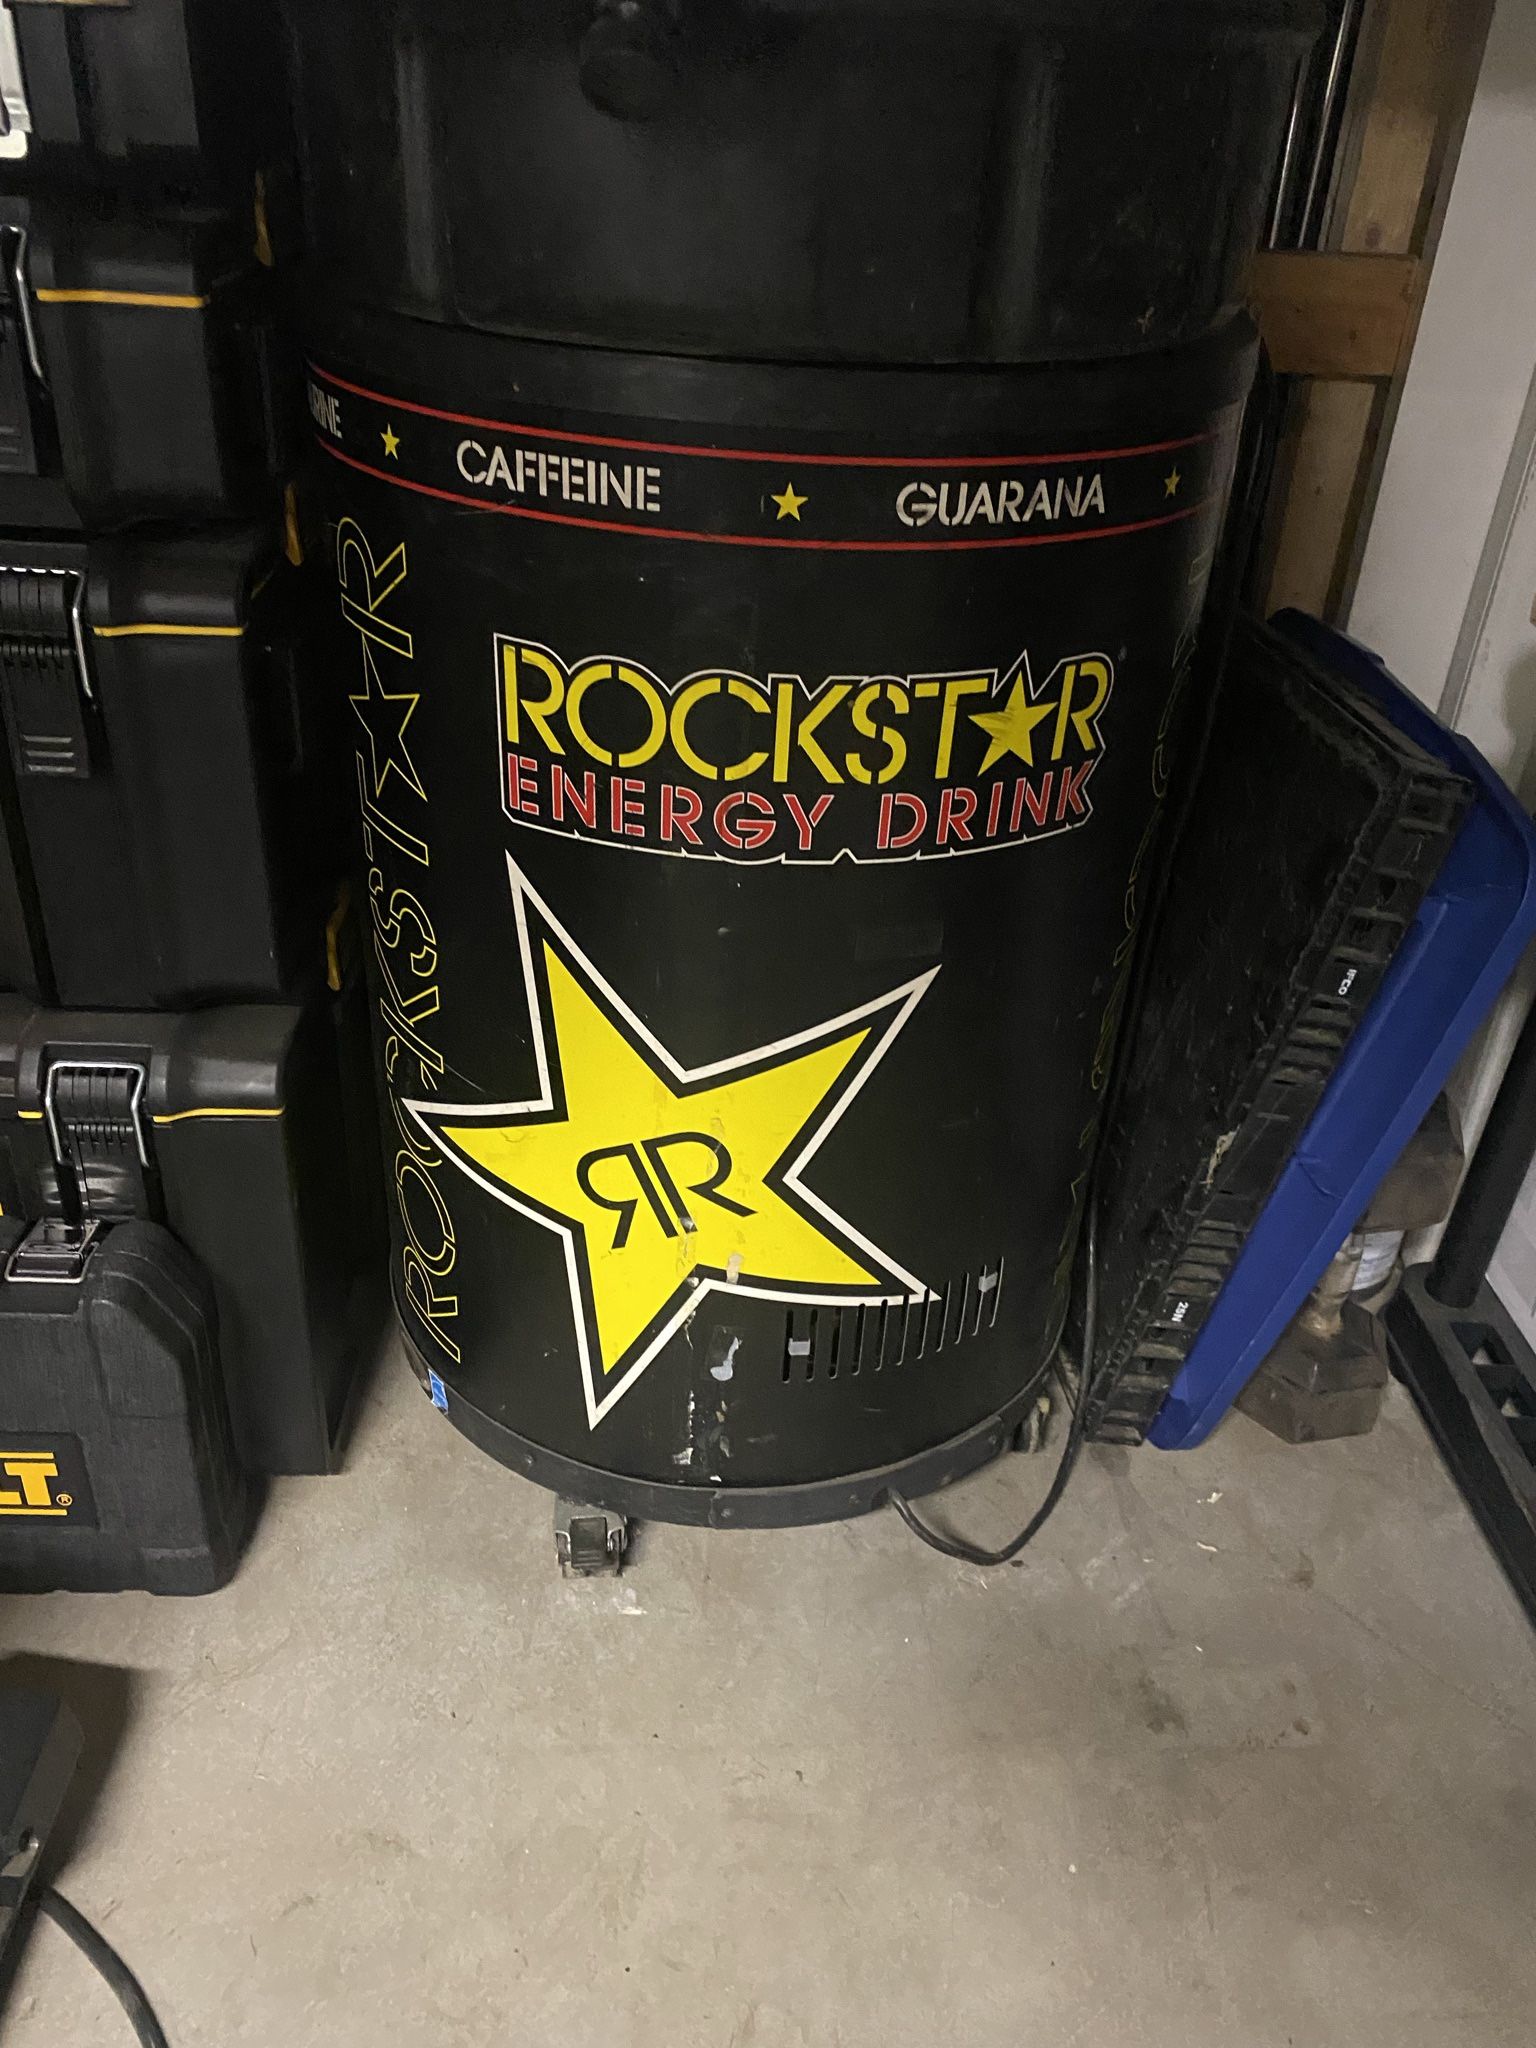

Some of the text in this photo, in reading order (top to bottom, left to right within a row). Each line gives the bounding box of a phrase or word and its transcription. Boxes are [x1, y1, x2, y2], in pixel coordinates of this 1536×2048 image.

[456, 439, 661, 512] CAFFEINE
[896, 473, 1105, 527] GUARANA
[507, 753, 1095, 851] ENERGY DRINK
[1338, 968, 1357, 995] IFCO
